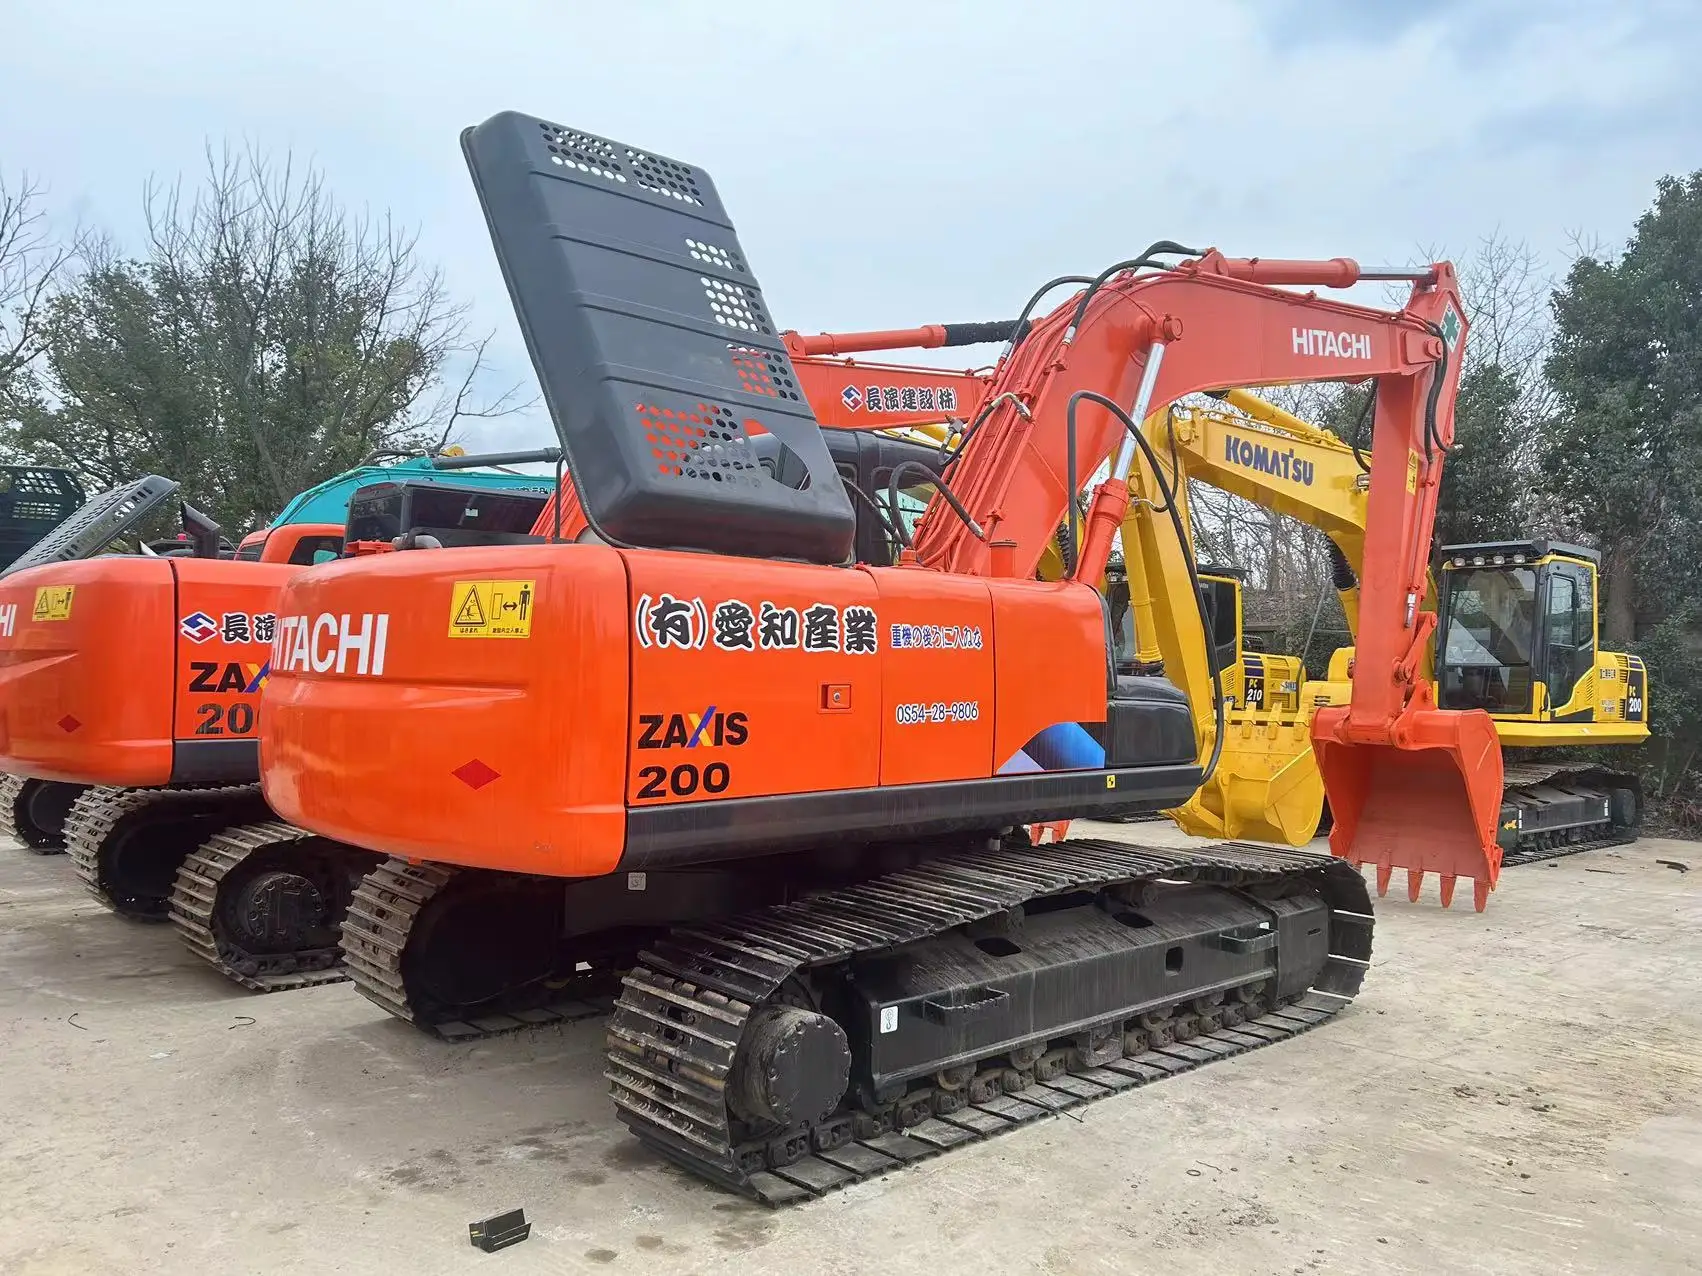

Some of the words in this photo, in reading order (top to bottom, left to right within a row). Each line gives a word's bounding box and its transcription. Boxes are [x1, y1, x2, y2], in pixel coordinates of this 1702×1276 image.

[1292, 327, 1371, 359] HITACHI
[1225, 434, 1314, 487] KOMATSU
[271, 612, 390, 676] HITACHI
[1246, 689, 1263, 701] 210
[1248, 679, 1258, 688] PC
[195, 703, 260, 735] 20
[1628, 697, 1642, 713] 200
[637, 705, 749, 749] ZAXIS
[636, 762, 730, 799] 200
